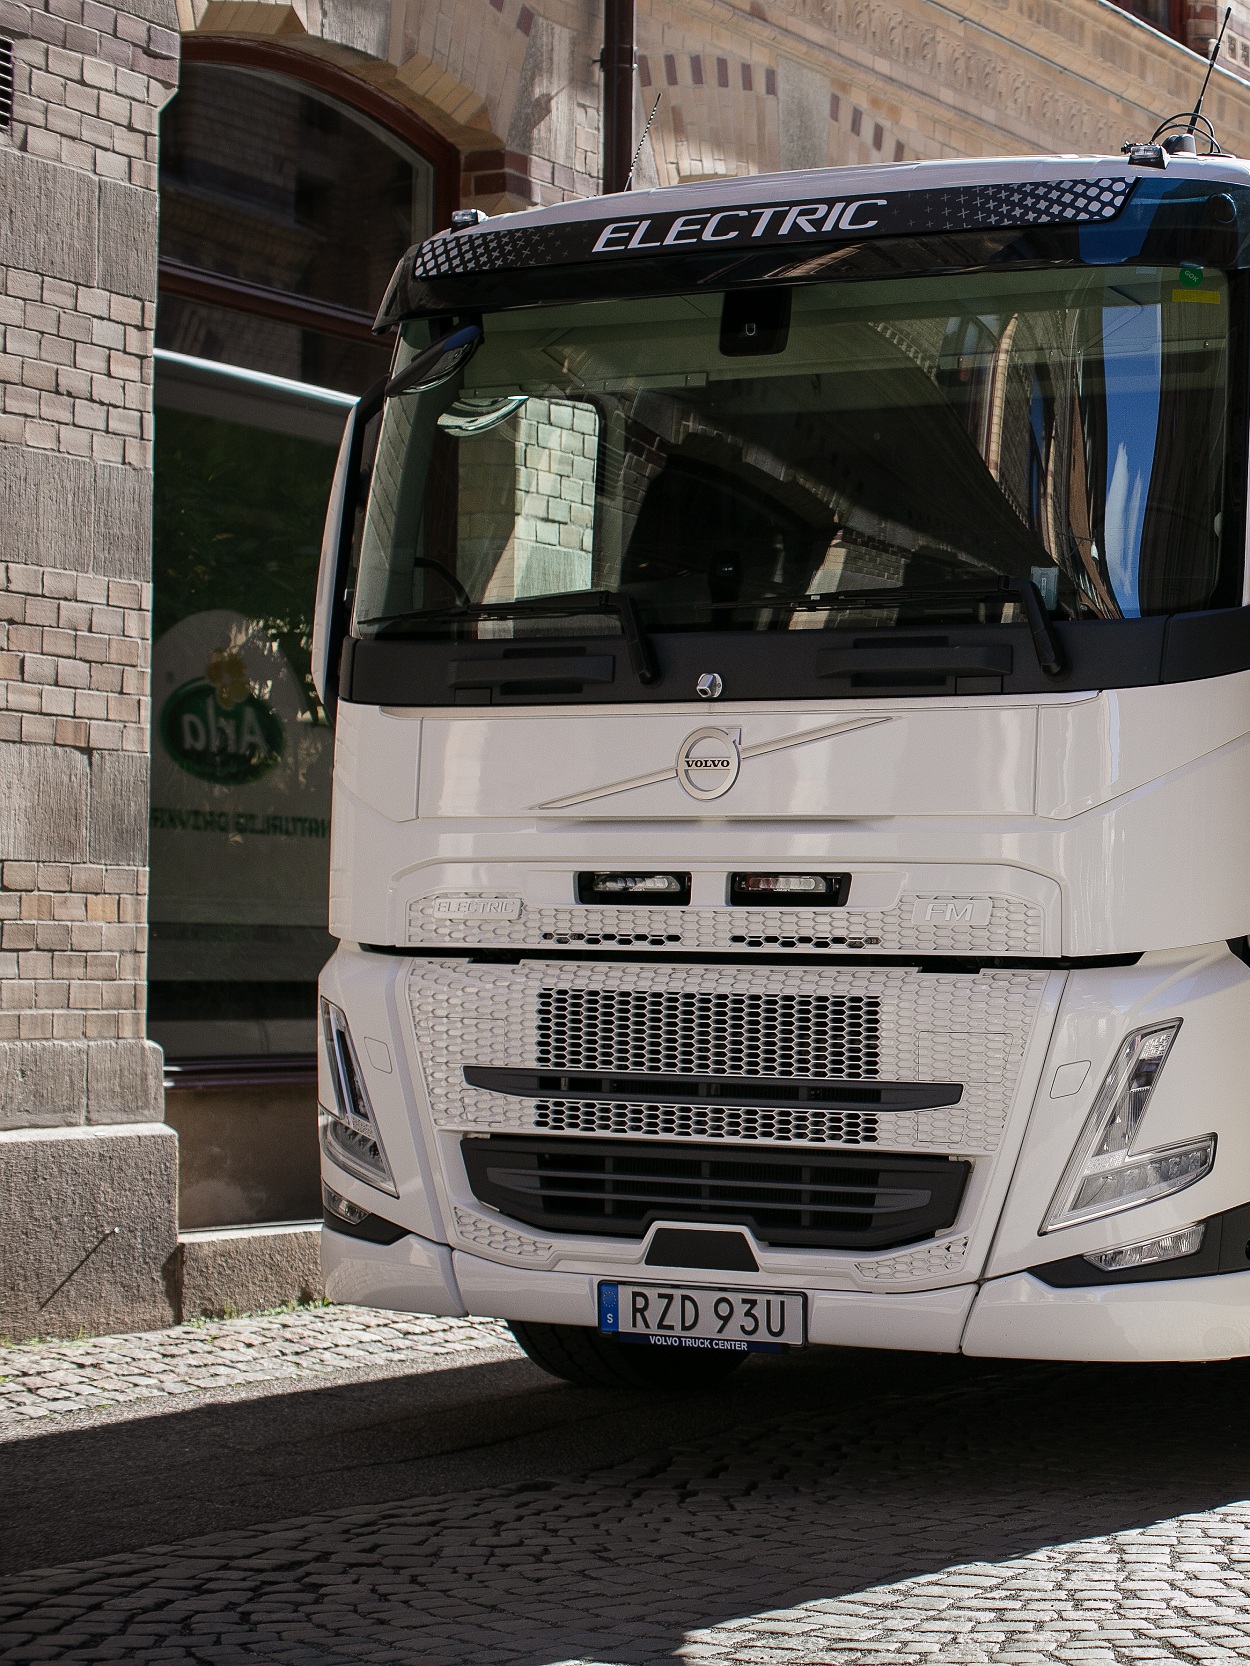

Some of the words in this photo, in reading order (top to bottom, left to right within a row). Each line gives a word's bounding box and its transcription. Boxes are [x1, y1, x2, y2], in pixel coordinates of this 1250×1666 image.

[592, 199, 887, 253] ELECTRIC
[685, 759, 730, 768] VOLVO
[437, 901, 514, 914] ELECTRIC
[925, 902, 974, 921] FM
[606, 1314, 613, 1324] S
[631, 1290, 699, 1331] RZD
[713, 1297, 785, 1337] 93U
[650, 1336, 678, 1346] VOLVO
[681, 1338, 711, 1348] TRUCK
[713, 1339, 748, 1351] CENTER
